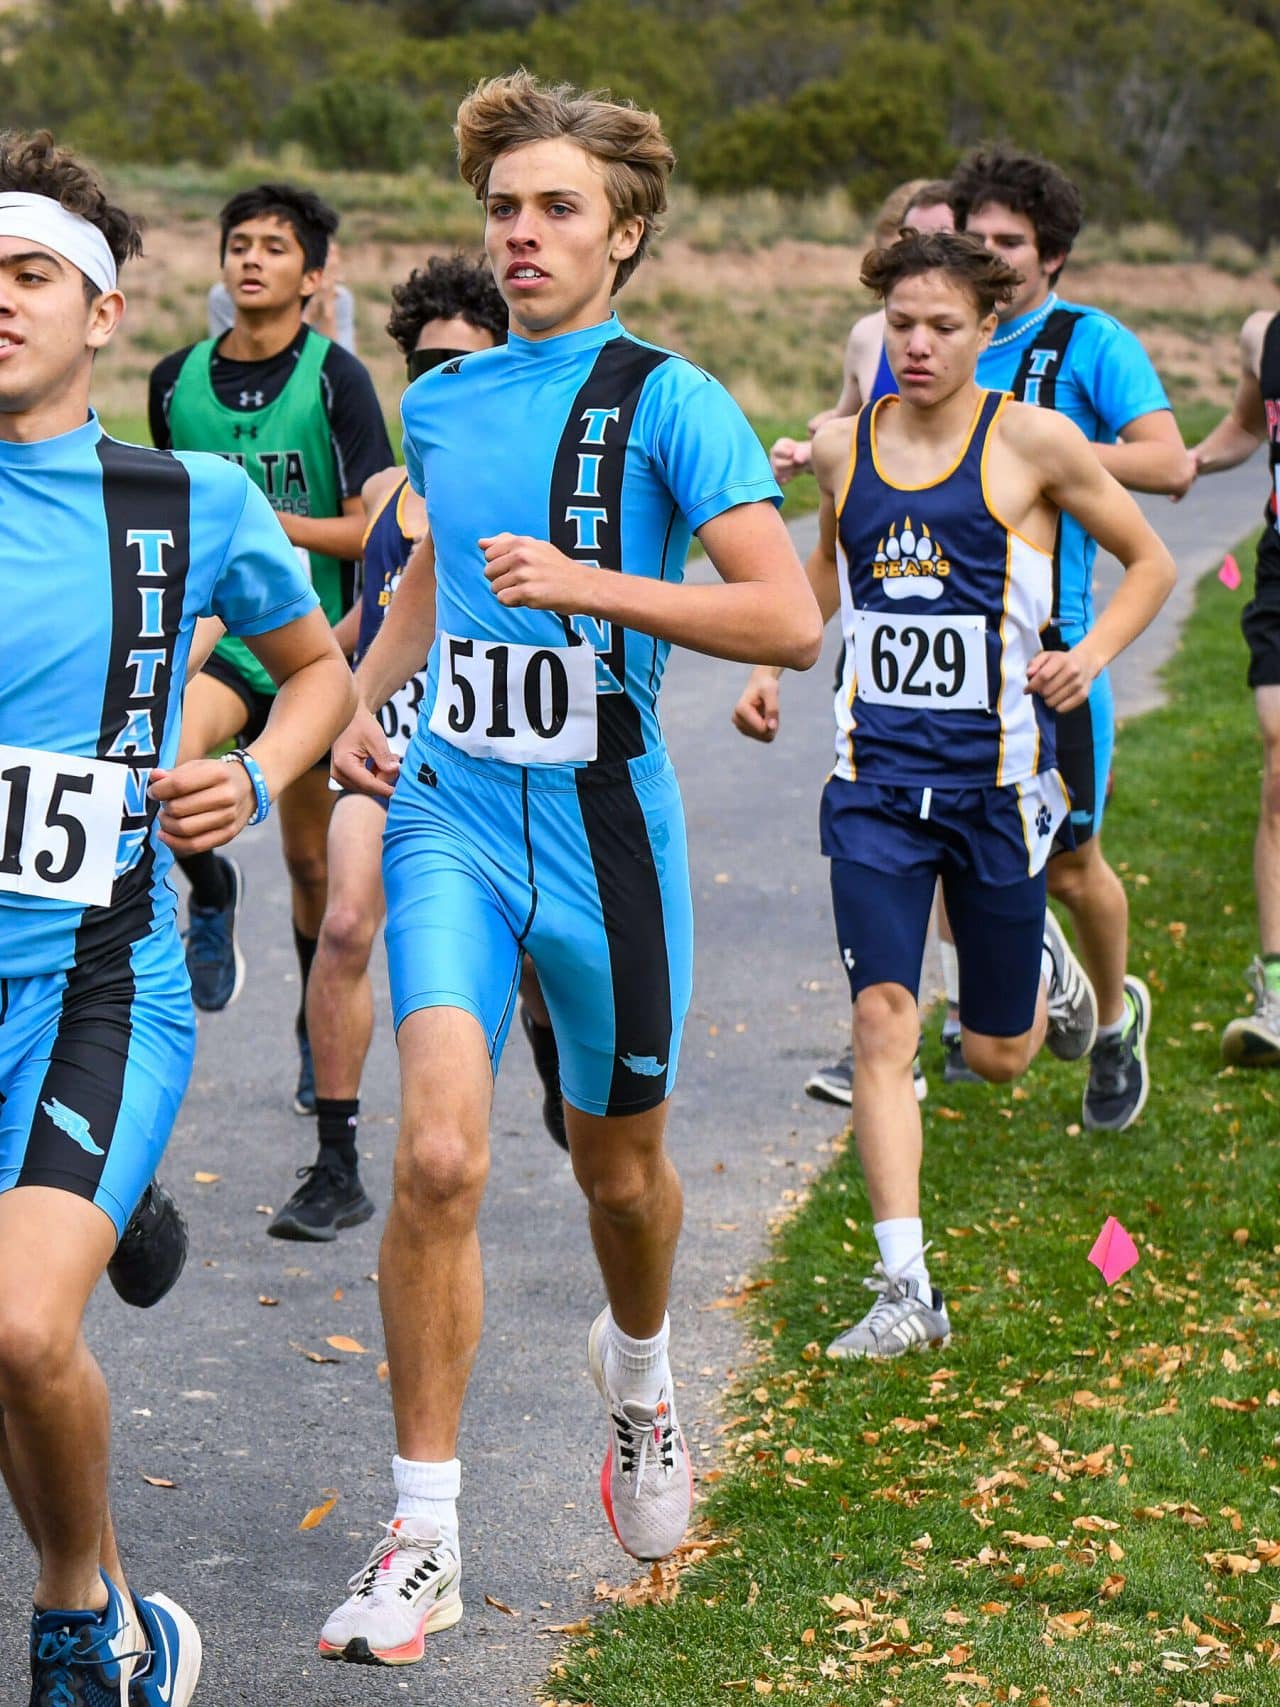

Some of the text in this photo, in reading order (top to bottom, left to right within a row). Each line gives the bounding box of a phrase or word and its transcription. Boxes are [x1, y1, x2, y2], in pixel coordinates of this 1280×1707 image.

[872, 560, 951, 579] BEARS
[448, 638, 570, 738] 510
[871, 624, 966, 698] 629
